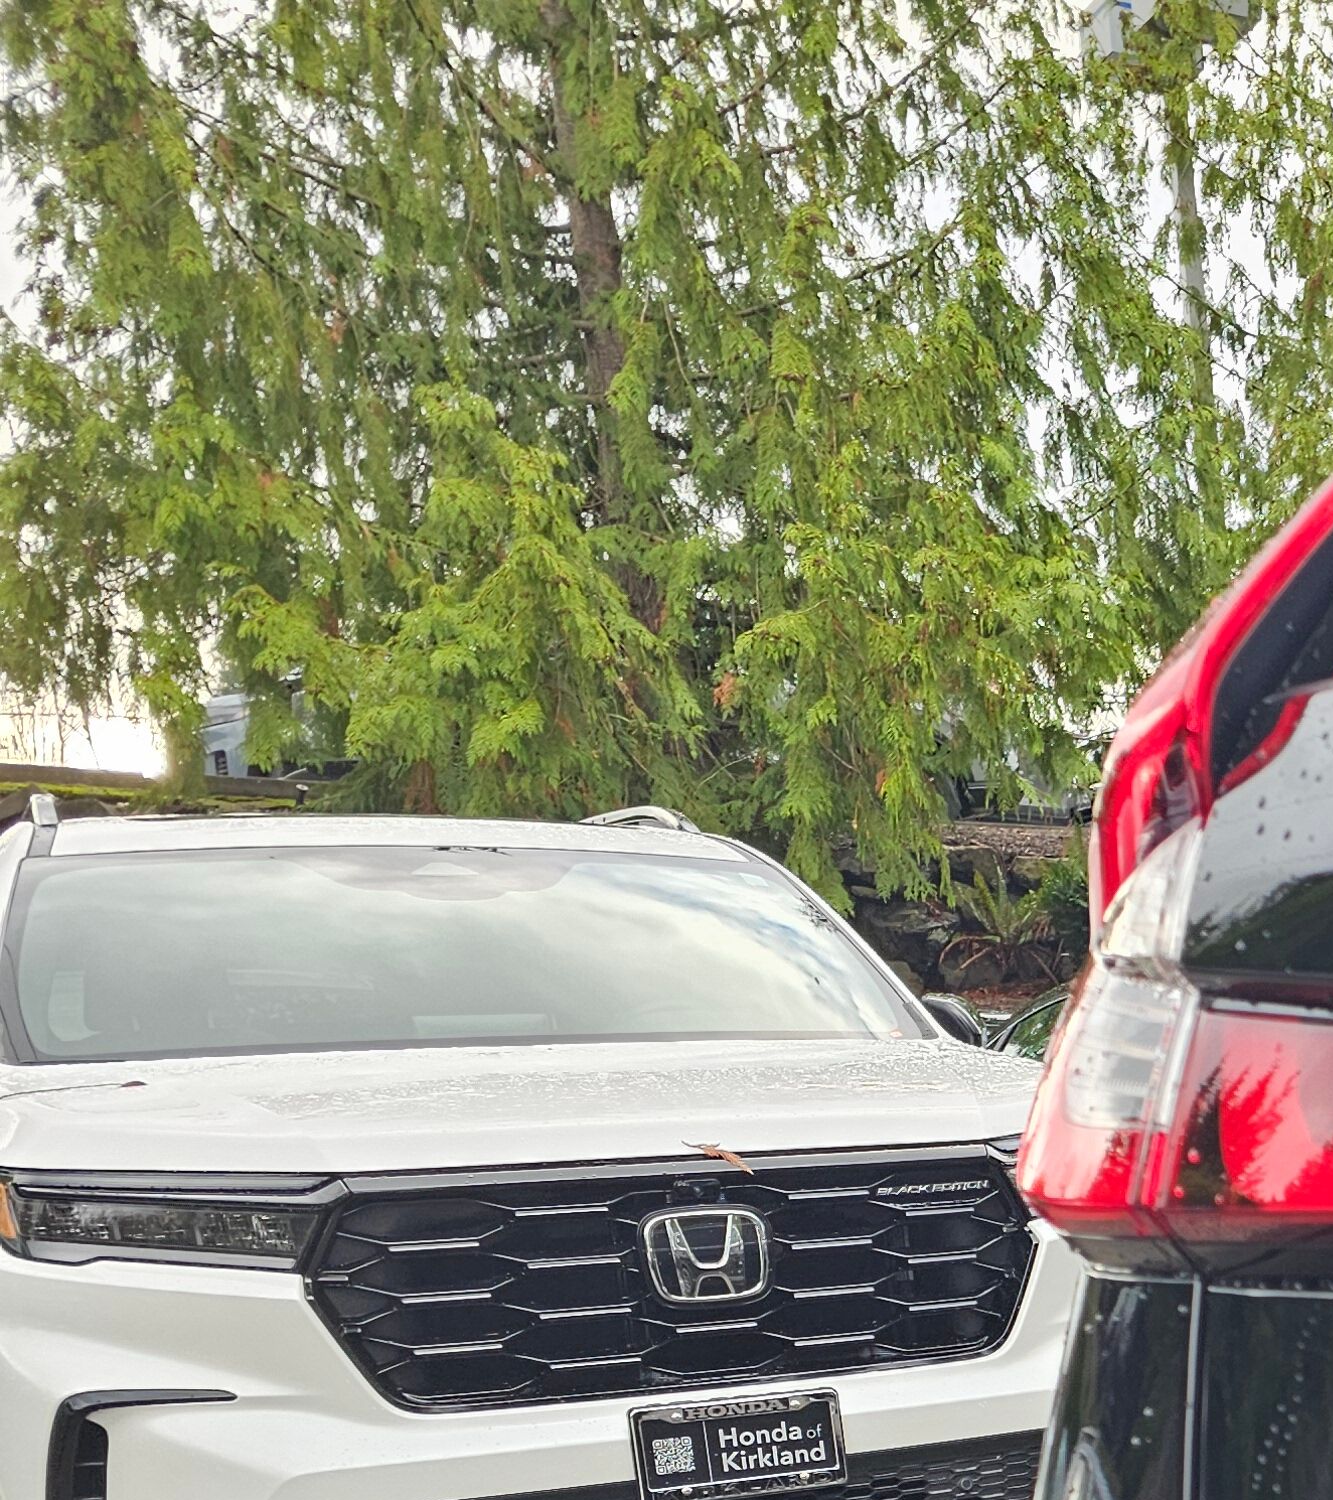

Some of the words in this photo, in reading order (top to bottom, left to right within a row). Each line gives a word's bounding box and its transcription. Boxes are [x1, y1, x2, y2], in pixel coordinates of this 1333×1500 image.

[876, 1184, 931, 1197] BLACK
[931, 1179, 989, 1193] EDITION
[683, 1397, 790, 1421] HONDA
[717, 1421, 803, 1449] Honda
[806, 1423, 824, 1440] of
[720, 1440, 827, 1473] Kirkland
